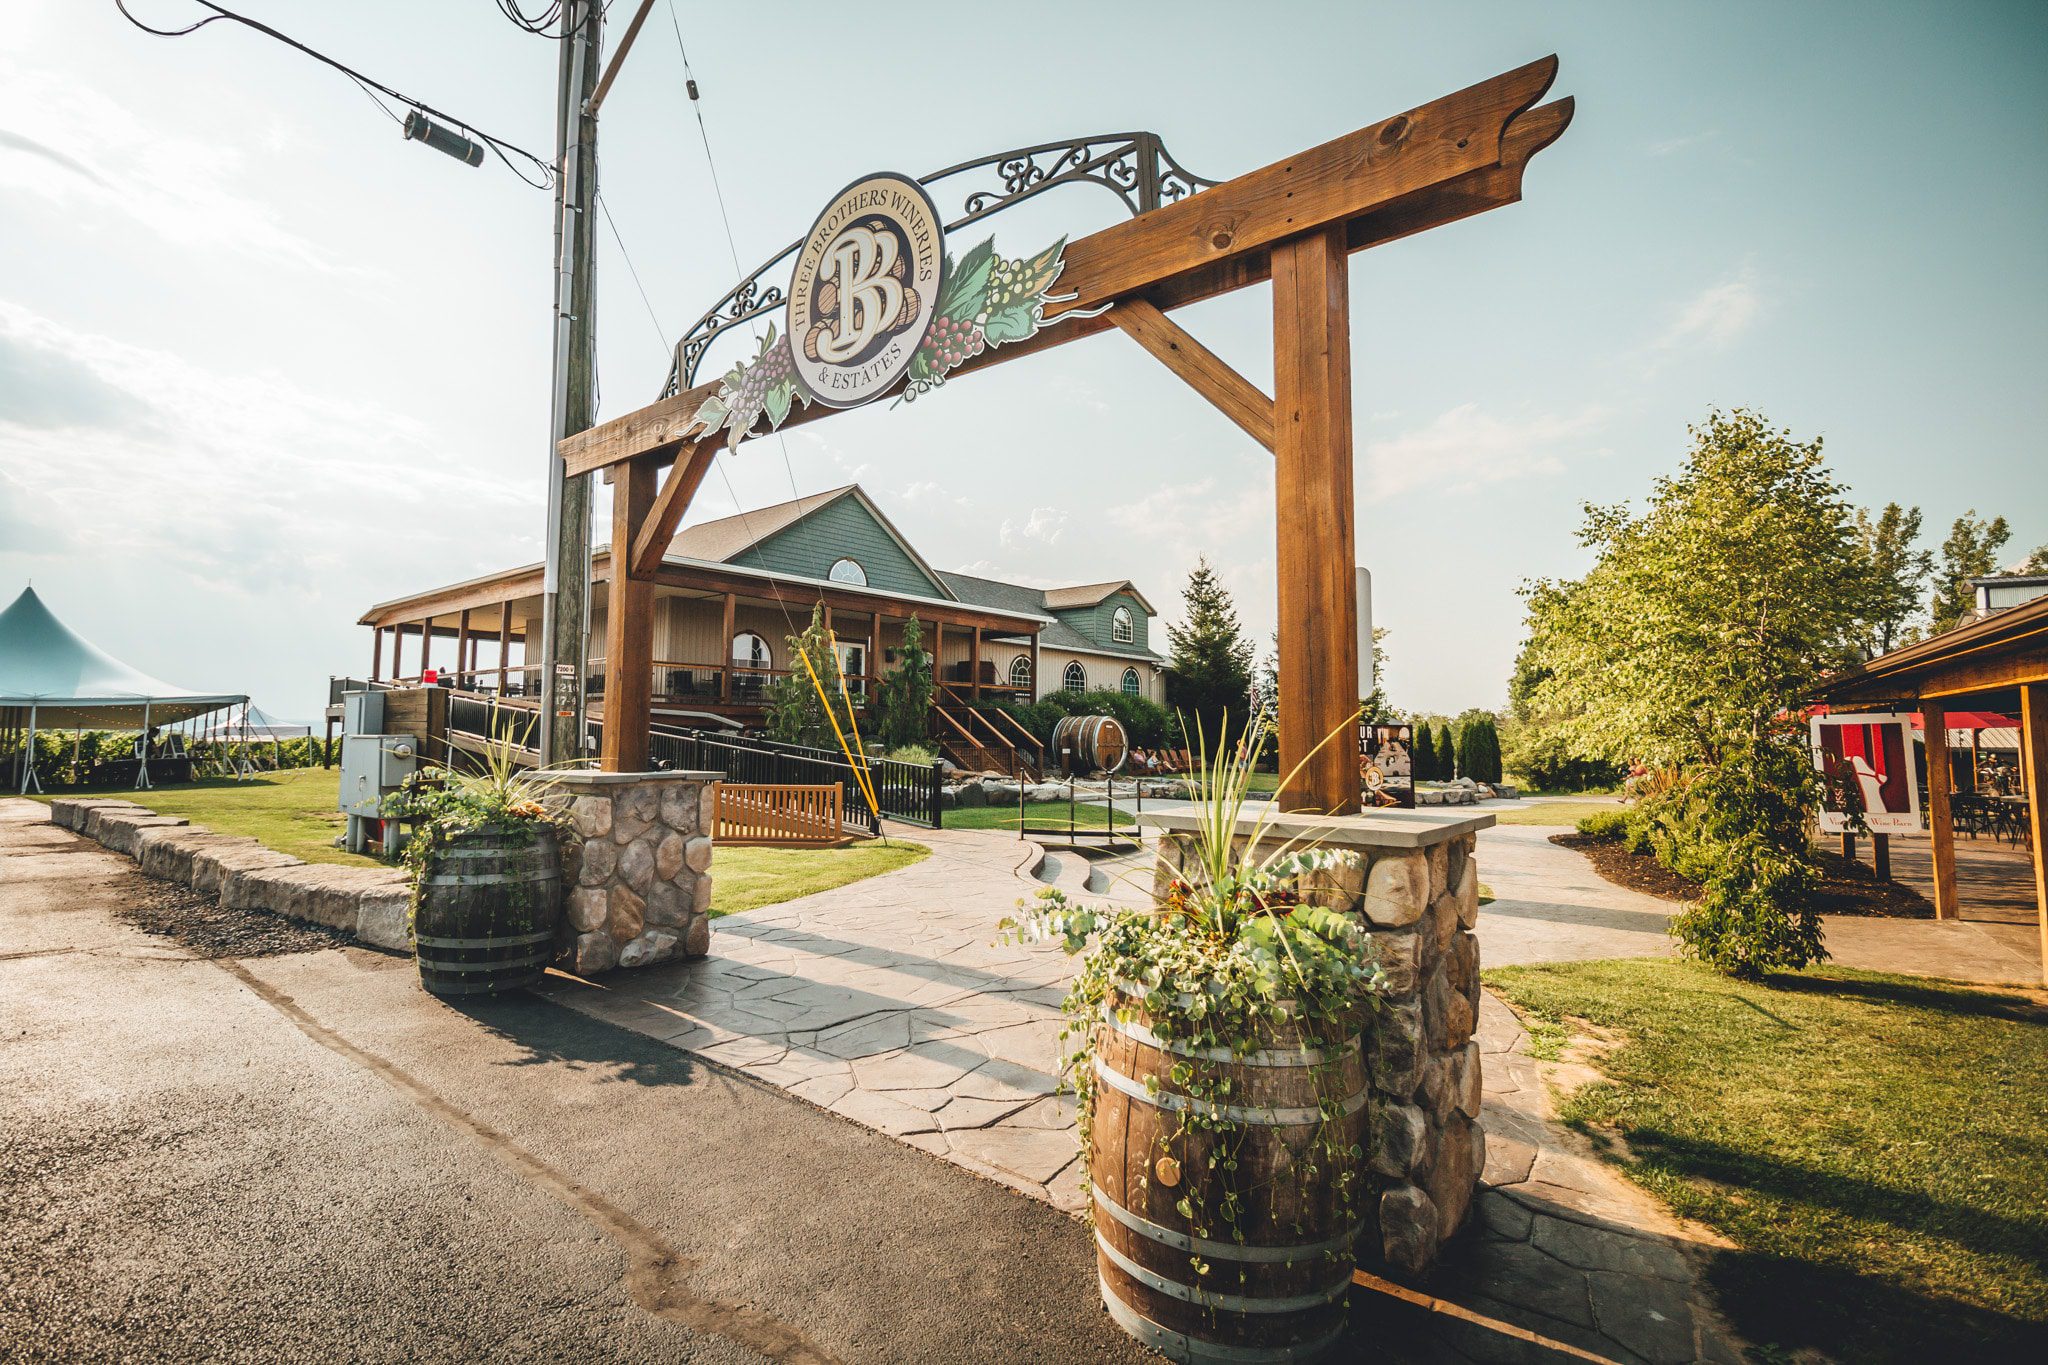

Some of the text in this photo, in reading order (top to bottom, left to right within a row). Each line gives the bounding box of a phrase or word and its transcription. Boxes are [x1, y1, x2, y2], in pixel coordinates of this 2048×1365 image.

[795, 189, 933, 331] THREE BROTHERS WINERIES
[818, 343, 901, 390] & ESTATES
[1359, 740, 1368, 752] ST
[1360, 726, 1373, 739] UR
